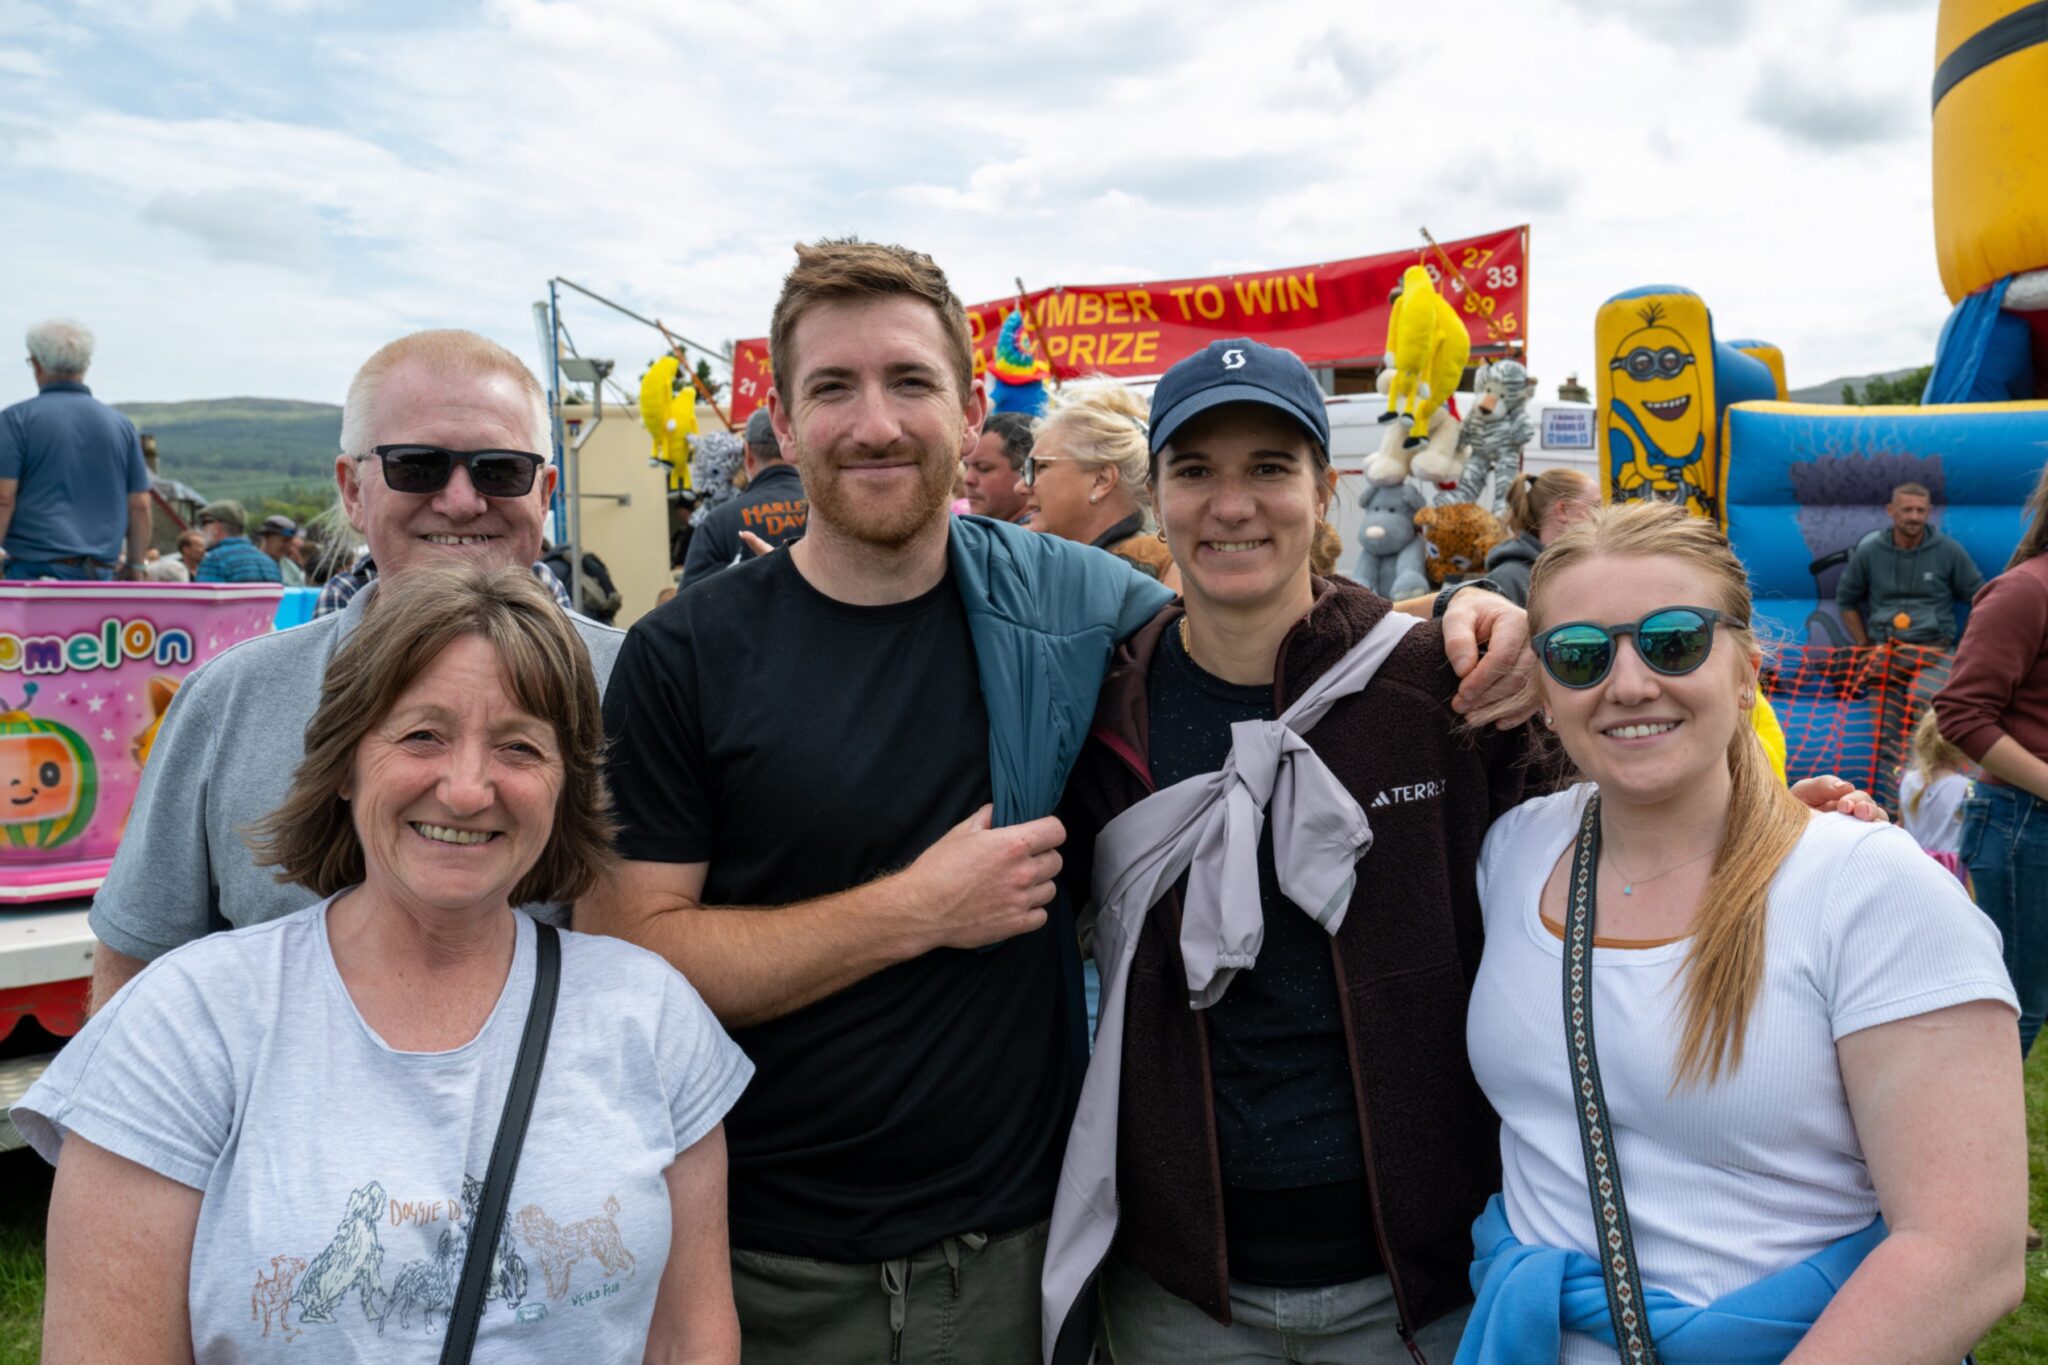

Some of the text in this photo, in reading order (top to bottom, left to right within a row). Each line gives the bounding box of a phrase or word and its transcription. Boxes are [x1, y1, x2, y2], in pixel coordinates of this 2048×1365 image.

[1462, 247, 1494, 269] 27
[1486, 265, 1518, 289] 33
[1169, 284, 1225, 321] TO
[1233, 272, 1320, 317] WIN
[1048, 331, 1161, 367] PRIZE
[738, 377, 757, 397] 21
[389, 1199, 443, 1227] DOGGIE
